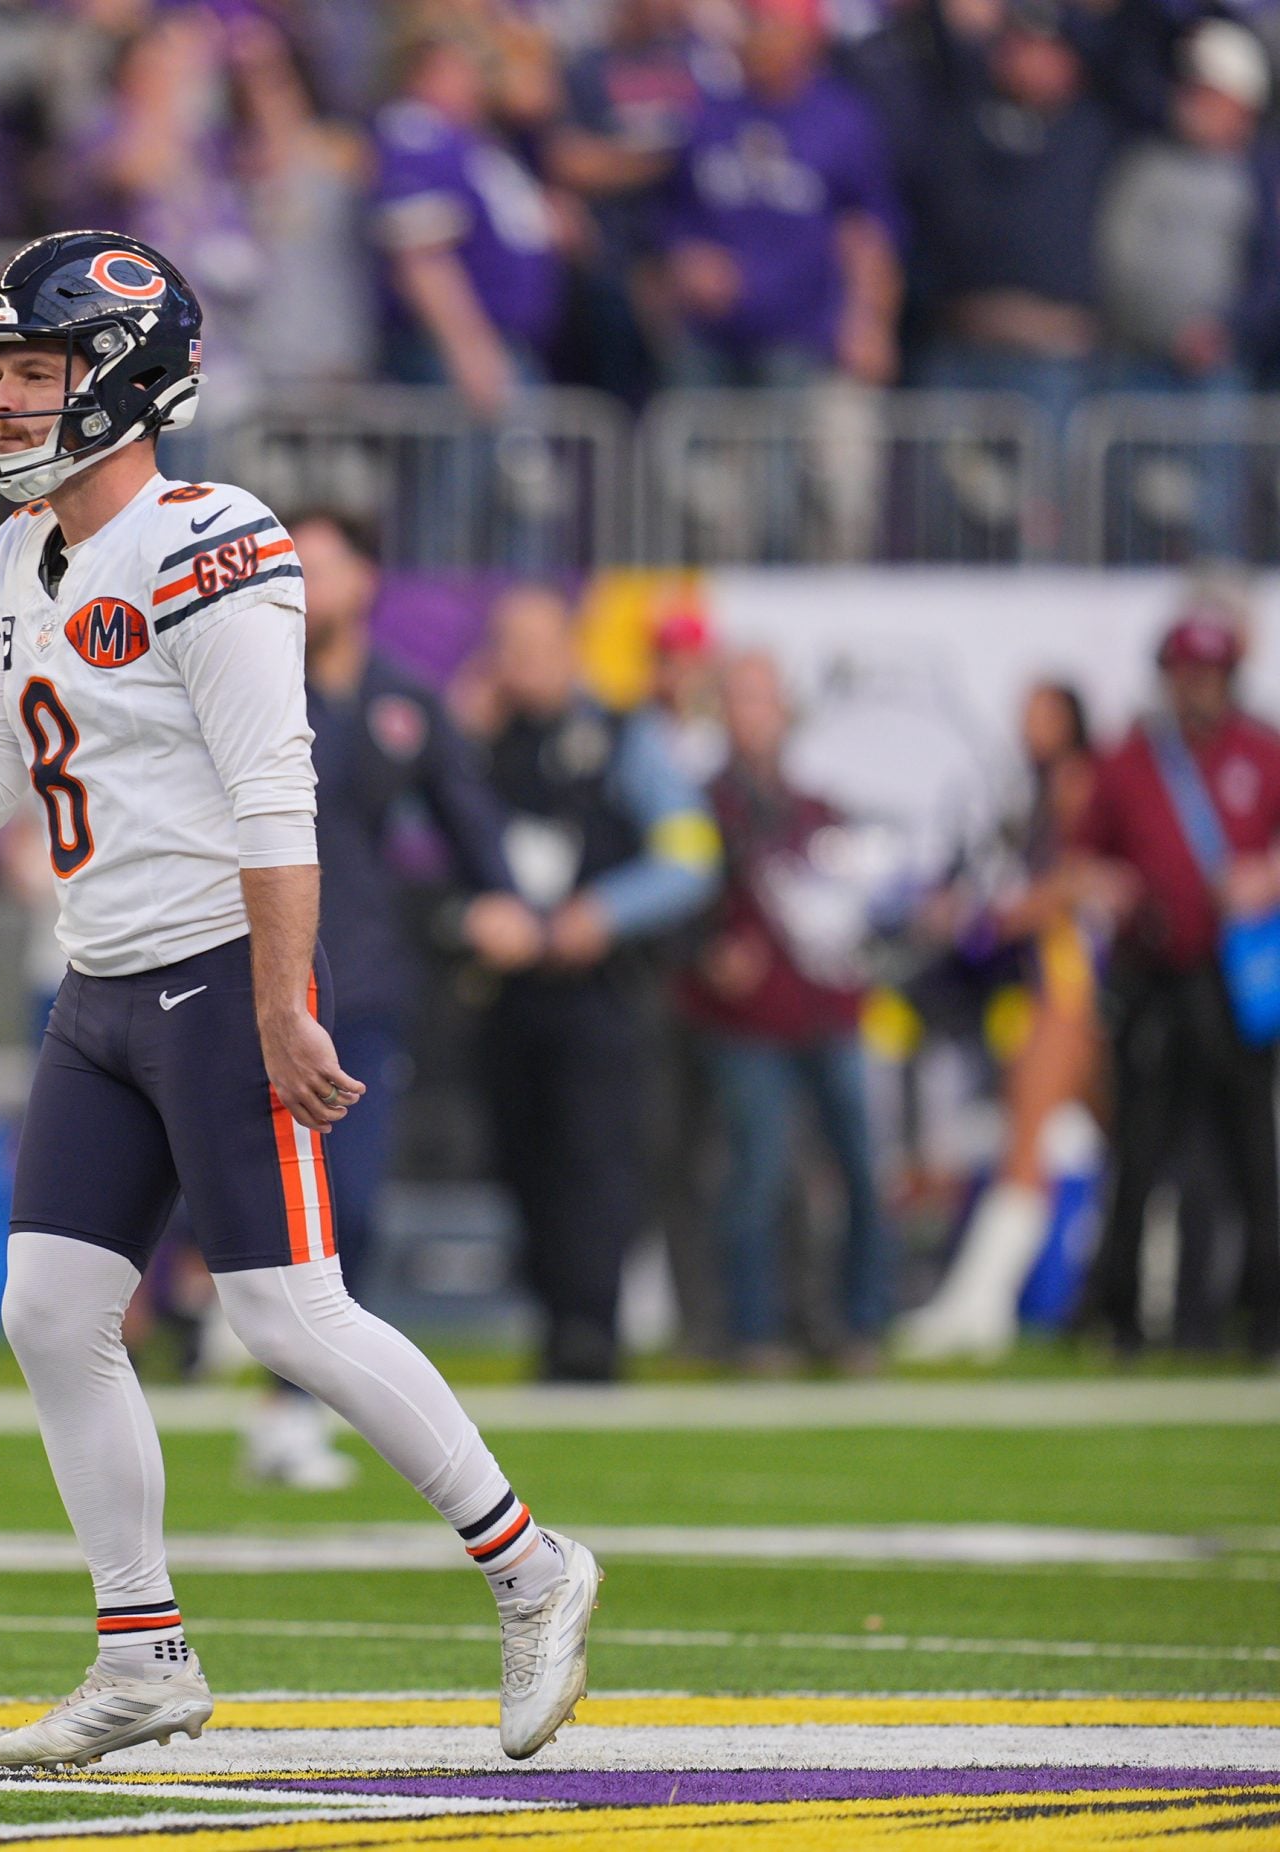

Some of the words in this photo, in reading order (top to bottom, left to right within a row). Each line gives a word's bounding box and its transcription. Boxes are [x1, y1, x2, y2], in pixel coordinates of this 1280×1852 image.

[85, 250, 166, 300] C
[192, 533, 260, 597] GSH
[19, 675, 95, 880] 8
